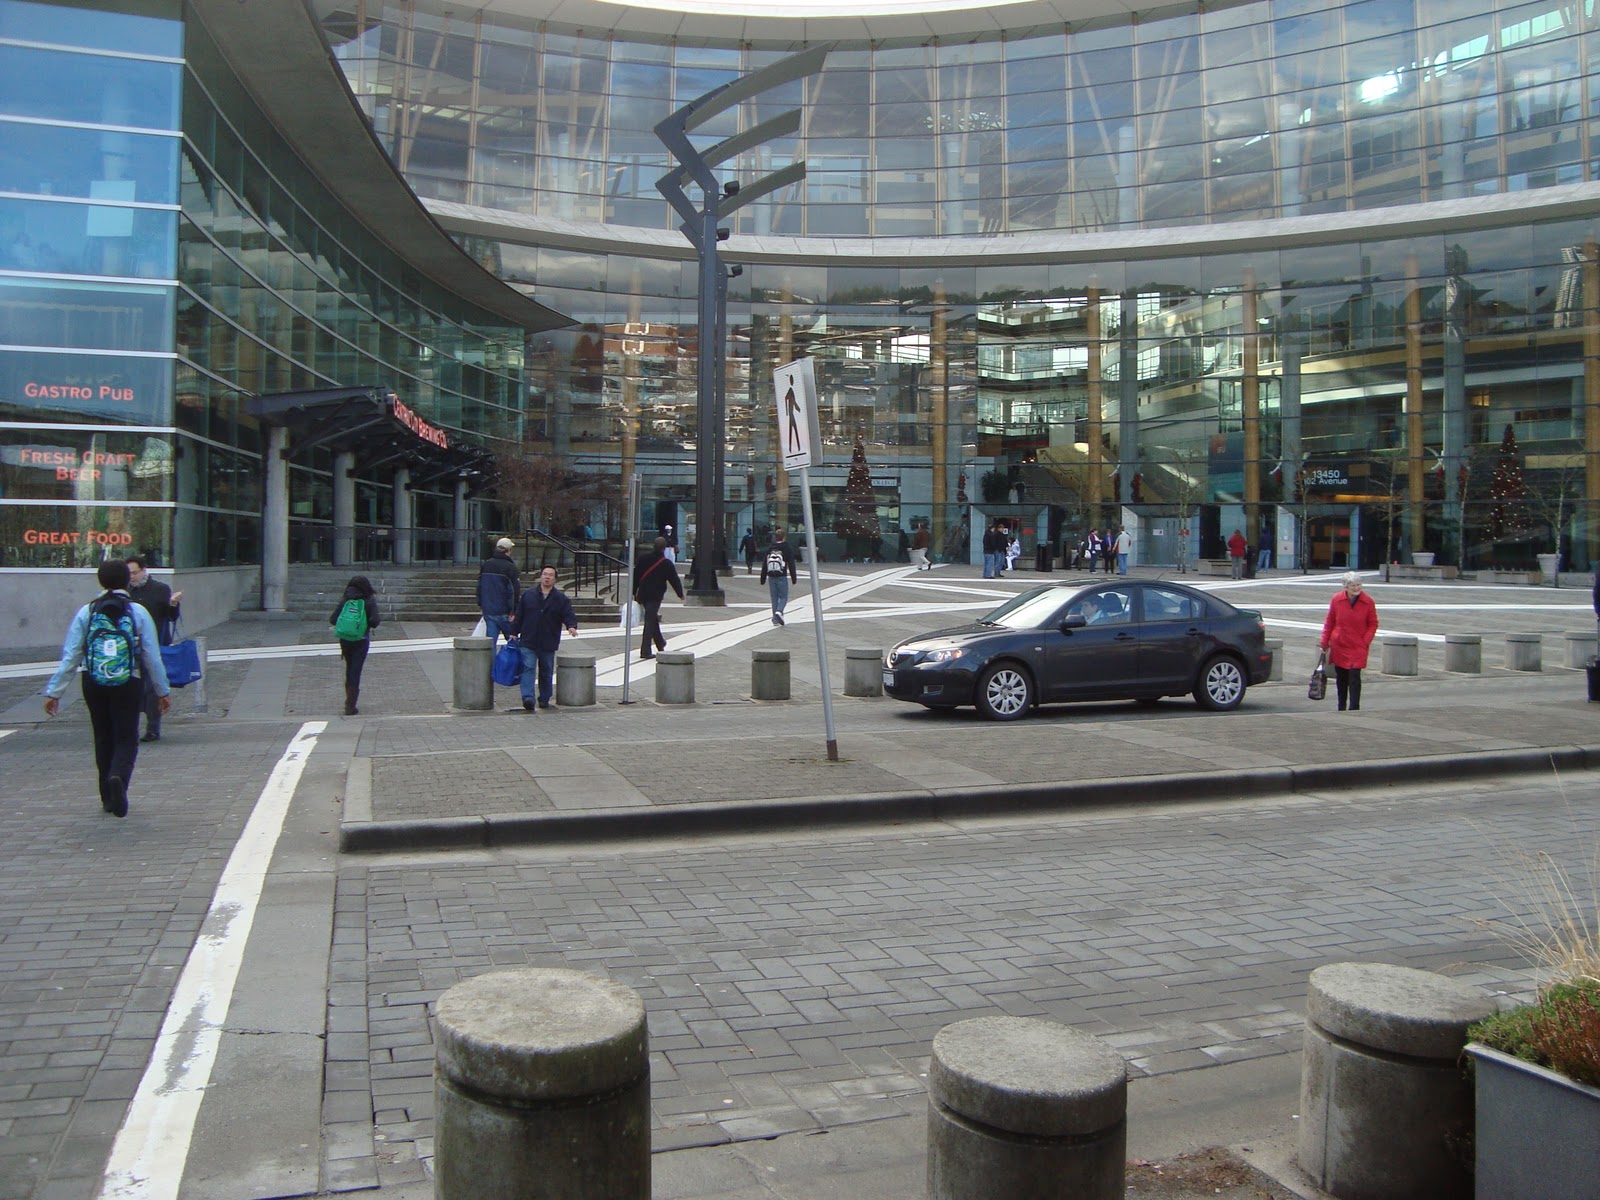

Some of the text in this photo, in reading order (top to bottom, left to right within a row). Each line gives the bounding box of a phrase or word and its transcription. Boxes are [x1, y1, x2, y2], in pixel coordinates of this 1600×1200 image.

[25, 383, 134, 400] GASTRO PUB
[21, 448, 136, 466] FRESH CRAFT
[56, 466, 101, 480] BEER
[1312, 469, 1340, 479] 13450
[24, 530, 132, 546] GREAT FOOD
